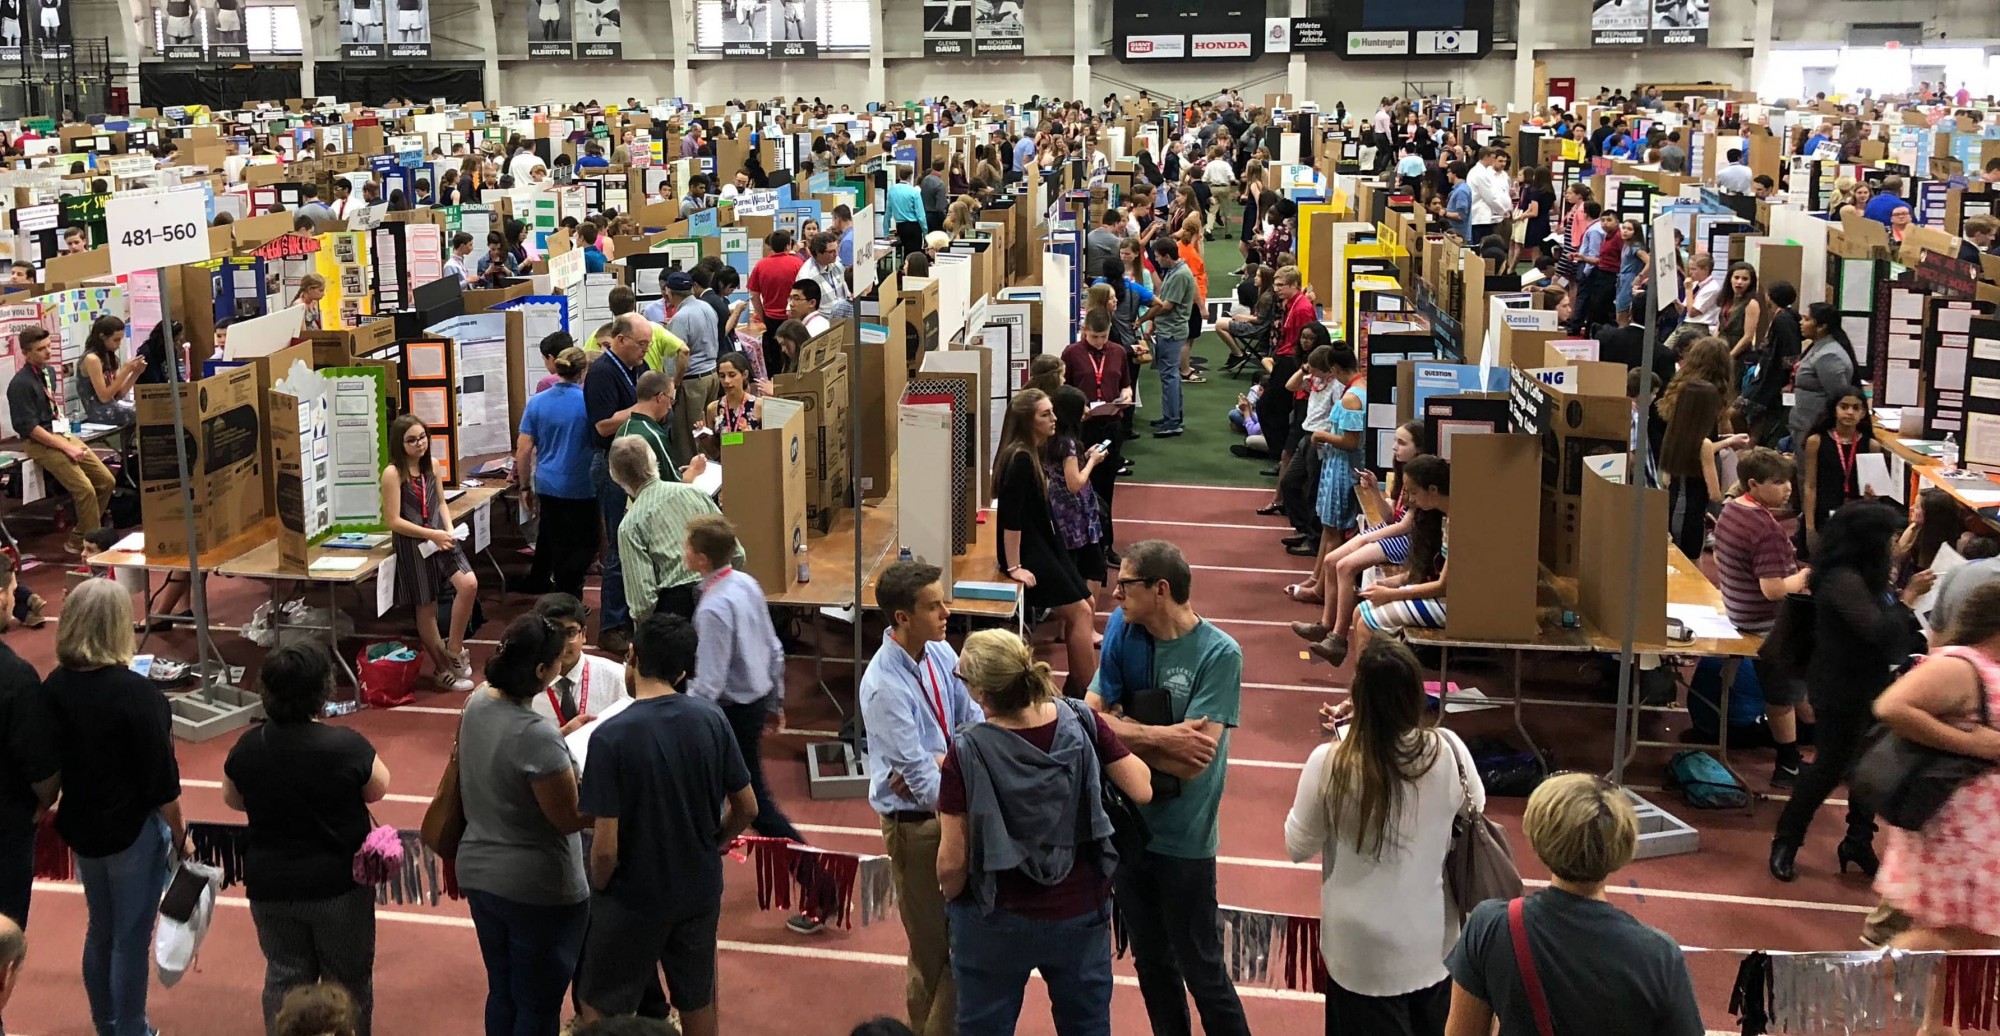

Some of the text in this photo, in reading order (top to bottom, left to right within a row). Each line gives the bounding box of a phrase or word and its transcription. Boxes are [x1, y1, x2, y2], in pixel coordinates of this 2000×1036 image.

[1299, 29, 1324, 37] Helping
[1361, 37, 1406, 48] Huntington
[1663, 35, 1696, 43] DIXON
[935, 45, 961, 53] DAVIS
[1194, 41, 1248, 49] HONDA
[121, 222, 197, 247] 481–560
[11, 307, 25, 317] you
[26, 307, 35, 316] to
[1506, 315, 1540, 324] Results
[1424, 370, 1452, 378] QUESTION
